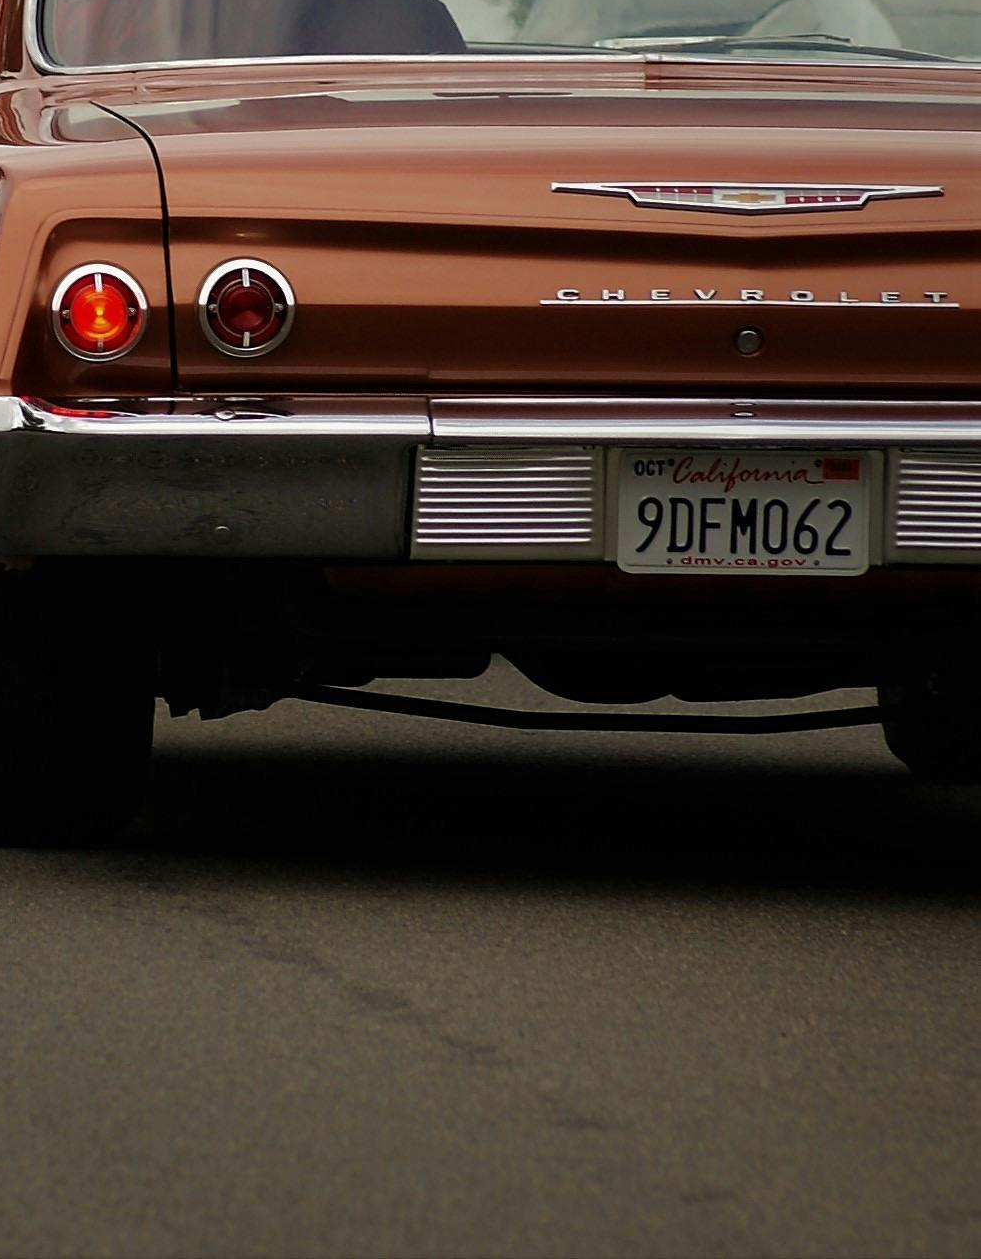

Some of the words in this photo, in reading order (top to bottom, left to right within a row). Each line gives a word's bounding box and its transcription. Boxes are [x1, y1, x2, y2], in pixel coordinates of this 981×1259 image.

[556, 288, 948, 303] CHEVROLET
[634, 460, 666, 477] OCT
[672, 456, 824, 493] California
[635, 496, 853, 556] 9DFM062
[680, 556, 807, 568] dmv.ca.gov
